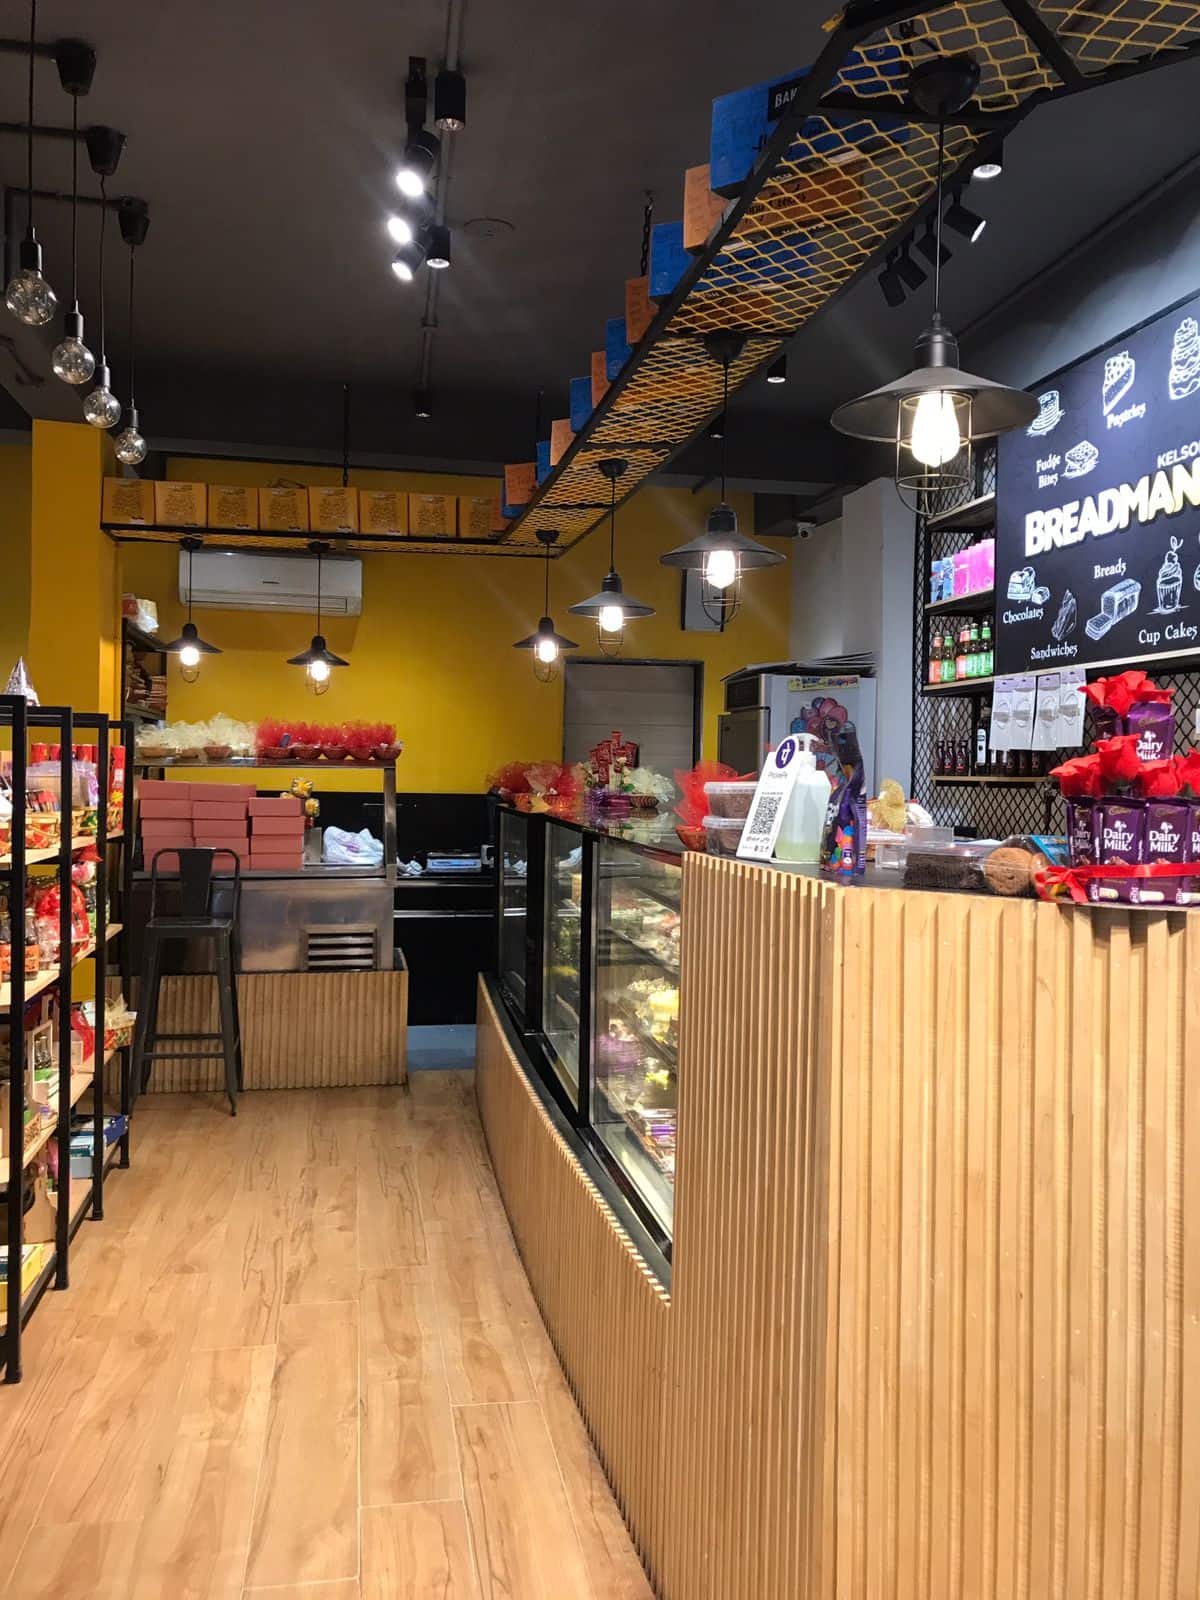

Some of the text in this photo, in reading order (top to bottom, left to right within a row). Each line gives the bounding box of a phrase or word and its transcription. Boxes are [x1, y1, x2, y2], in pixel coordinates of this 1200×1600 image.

[1157, 441, 1200, 469] KELSO
[1025, 456, 1200, 557] BREADMAN
[1094, 558, 1126, 579] Breads
[1003, 606, 1044, 624] Chocolates
[1138, 621, 1198, 646] Cup Cakes
[1030, 641, 1078, 660] Sandwiches
[1103, 828, 1134, 844] Dairy
[1104, 839, 1132, 851] Milk
[1149, 830, 1180, 844] Dairy
[1150, 841, 1178, 853] Milk
